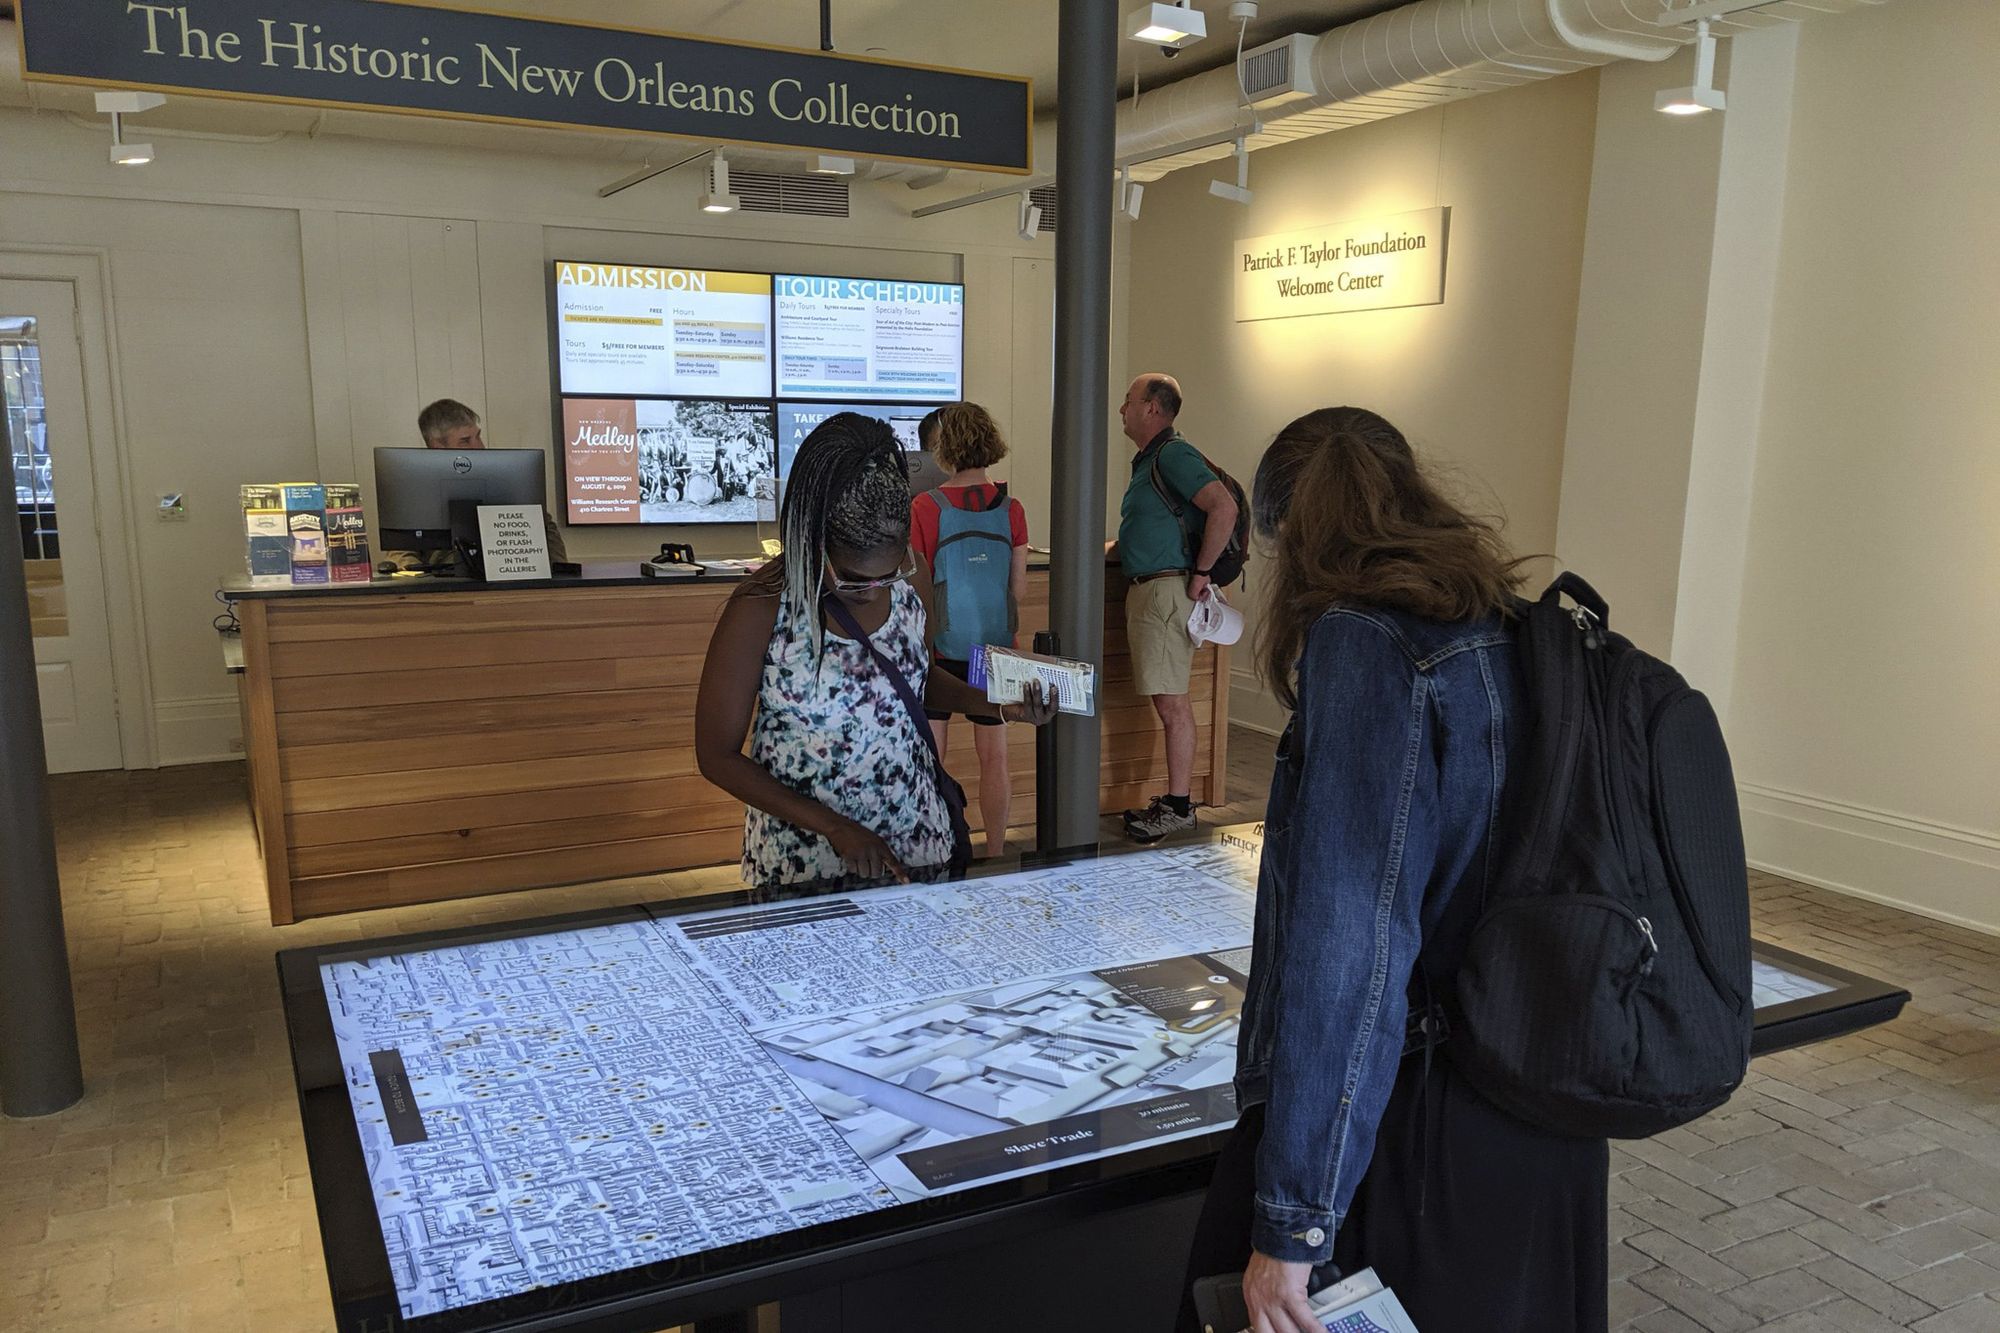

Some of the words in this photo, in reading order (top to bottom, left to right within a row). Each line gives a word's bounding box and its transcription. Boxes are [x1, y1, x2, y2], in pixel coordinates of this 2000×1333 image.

[126, 1, 242, 63] The
[257, 19, 461, 85] Historic
[475, 43, 584, 97] New
[594, 57, 754, 117] Orleans
[769, 78, 961, 138] Collection
[1243, 249, 1284, 272] Patrick
[1287, 247, 1297, 266] F.
[1301, 241, 1341, 268] Taylor
[1345, 232, 1426, 259] Foundation
[559, 264, 706, 292] ADMISSION
[1277, 277, 1334, 297] Welcome
[1338, 271, 1384, 292] Center
[777, 277, 840, 299] TOUR
[848, 281, 961, 304] SCHEDULE
[564, 302, 604, 312] Admission
[780, 302, 796, 311] Daily
[875, 306, 902, 315] Specialty
[794, 413, 823, 423] TAKE
[571, 426, 634, 453] Medley
[794, 428, 802, 438] A
[329, 514, 363, 530] Medley
[1152, 1102, 1190, 1114] minutes
[1175, 1116, 1201, 1125] miles
[1004, 1141, 1046, 1154] Slave
[1046, 1130, 1094, 1144] Trade
